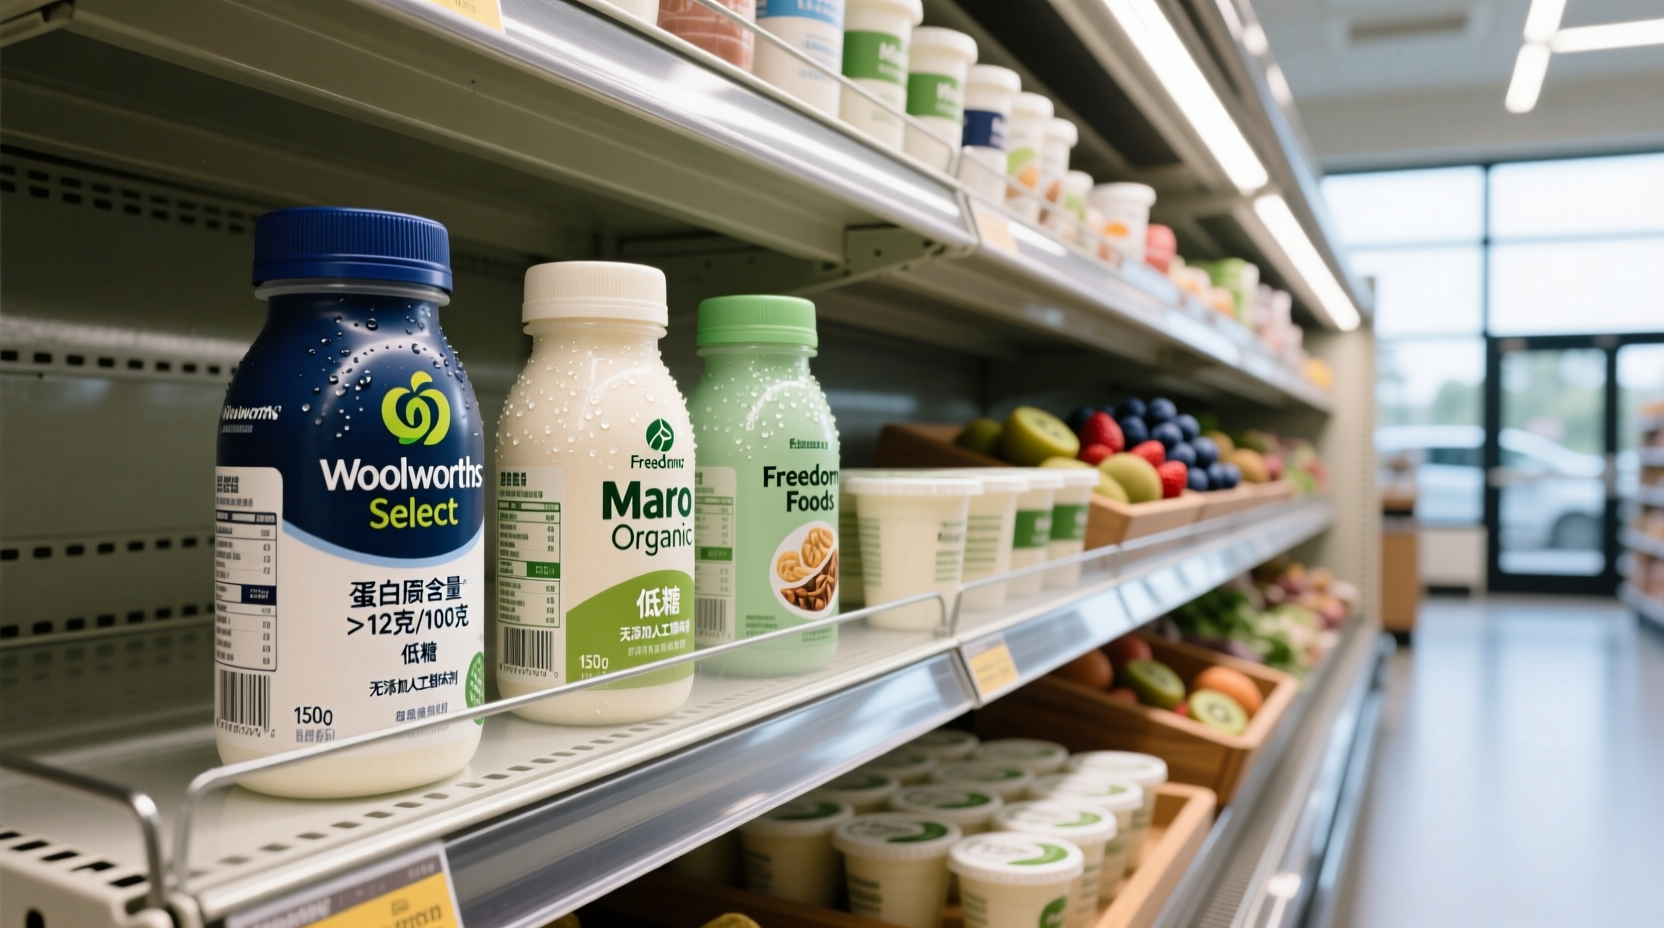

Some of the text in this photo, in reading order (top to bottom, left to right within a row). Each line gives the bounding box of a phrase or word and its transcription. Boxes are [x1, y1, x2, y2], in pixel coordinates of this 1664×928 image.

[319, 456, 483, 491] Woolworths
[763, 463, 839, 488] Freedom
[369, 496, 459, 529] Select
[602, 481, 692, 520] Maro
[786, 489, 834, 512] Foods
[611, 522, 693, 556] Organic
[636, 584, 681, 619] 低糖
[346, 603, 469, 636] >12克/100克
[401, 640, 437, 665] 低糖
